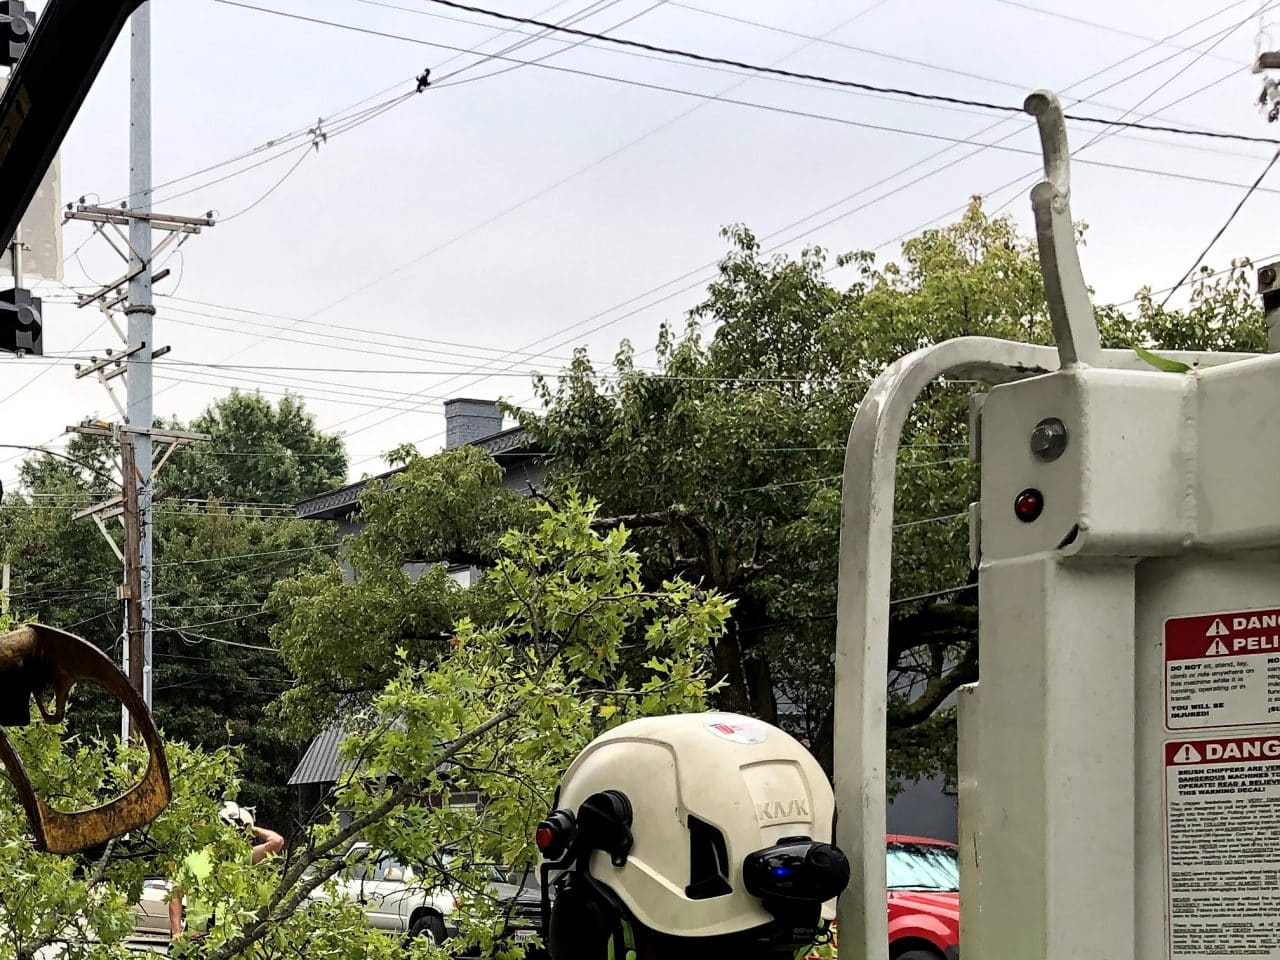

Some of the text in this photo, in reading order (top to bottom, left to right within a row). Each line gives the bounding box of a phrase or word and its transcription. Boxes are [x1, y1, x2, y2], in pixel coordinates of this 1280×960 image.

[1232, 614, 1280, 631] DAN
[1184, 663, 1201, 671] NOT
[1190, 702, 1211, 710] WILL
[1206, 740, 1280, 760] DANG
[1206, 766, 1245, 774] CHIPPERS
[1178, 774, 1226, 783] DANGEROUS
[1227, 772, 1269, 780] MACHINES
[1198, 787, 1236, 796] WARNING
